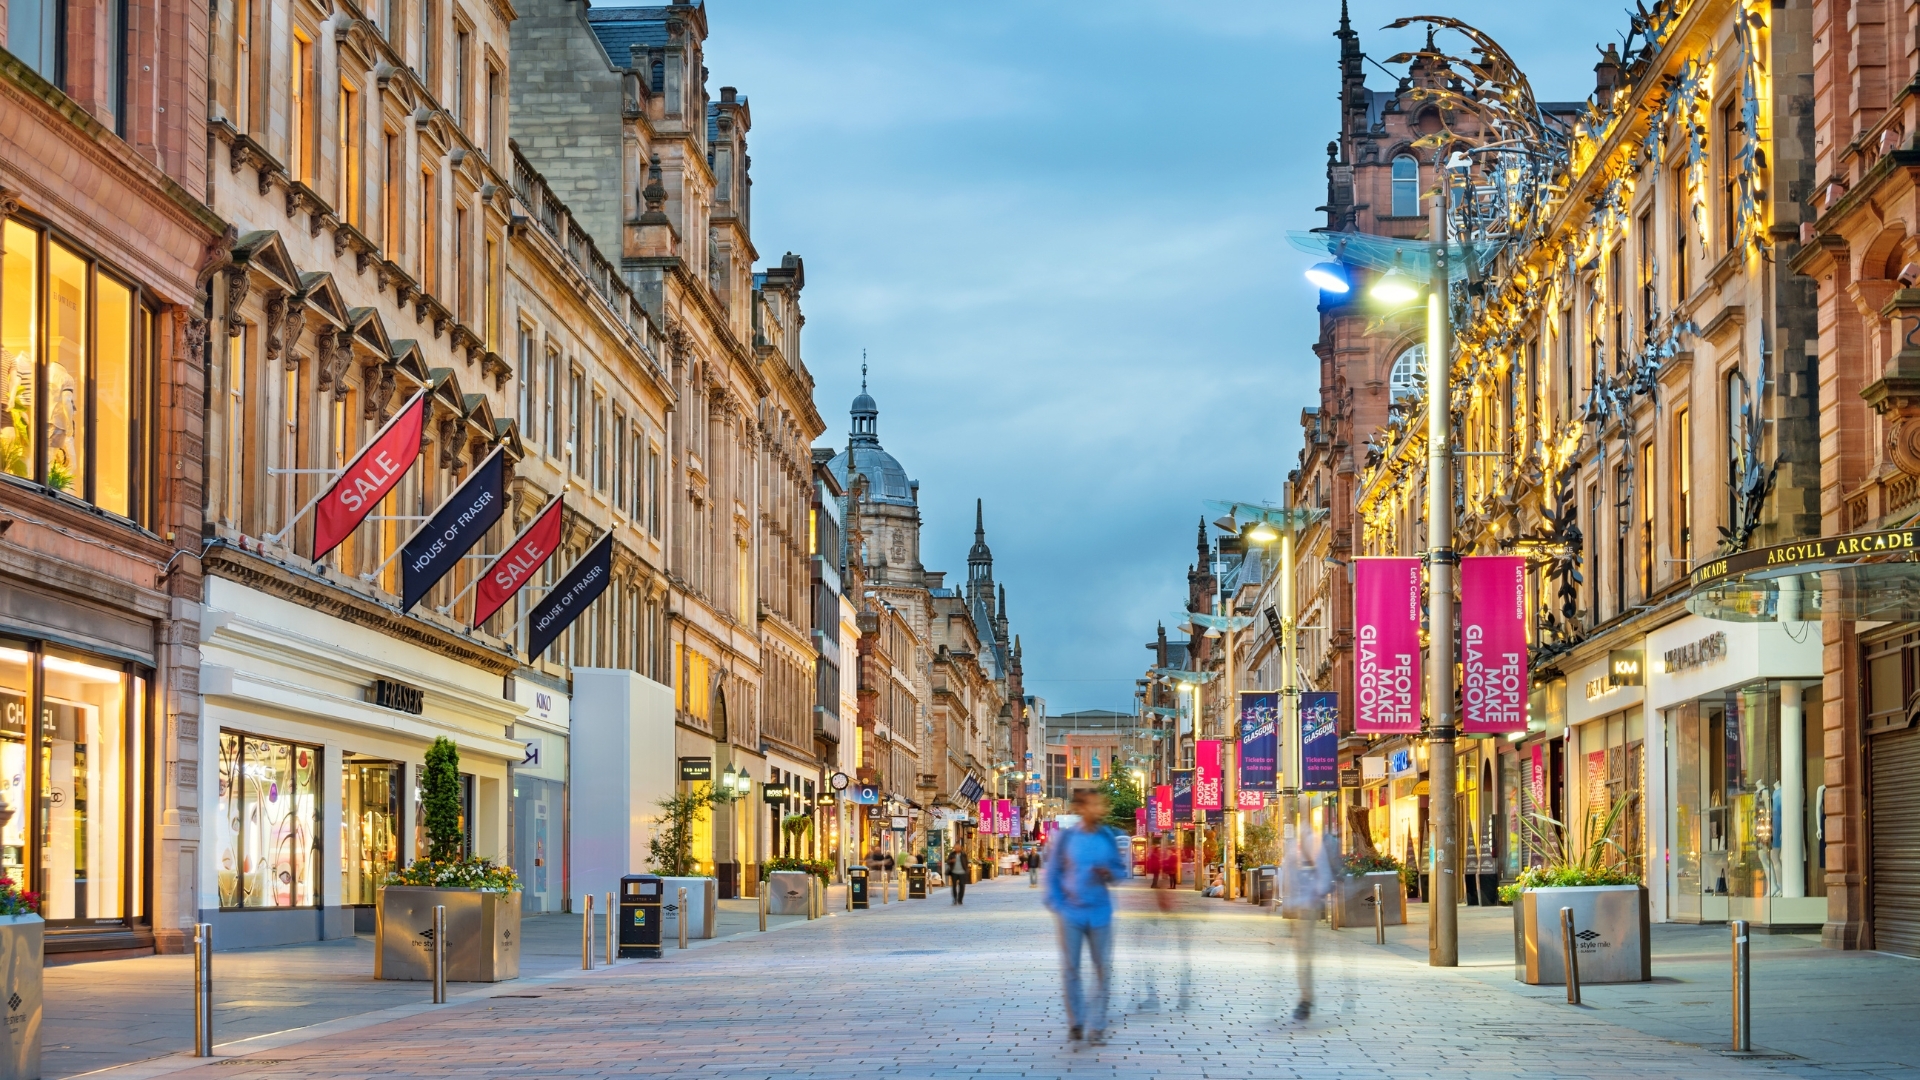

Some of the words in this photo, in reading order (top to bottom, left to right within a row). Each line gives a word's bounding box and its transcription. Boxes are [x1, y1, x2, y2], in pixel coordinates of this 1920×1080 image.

[53, 291, 77, 311] HOWICK
[340, 450, 401, 512] SALE
[412, 538, 447, 573] HOUSE
[444, 524, 459, 541] OF
[457, 491, 494, 527] FRASER
[1767, 543, 1825, 565] ARGYLL
[1836, 531, 1913, 555] ARCADE
[495, 540, 544, 590] SALE
[1700, 560, 1727, 582] ARCADE
[535, 603, 564, 632] HOUSE
[561, 591, 574, 606] OF
[572, 565, 603, 596] FRASER
[1409, 586, 1417, 621] Celebrate
[1360, 624, 1377, 723] GLASGOW
[1466, 624, 1484, 722] GLASGOW
[1615, 660, 1638, 674] KM
[384, 681, 425, 714] FRASERS
[536, 692, 551, 711] KIKO
[1378, 669, 1394, 723] MAKE
[1395, 654, 1411, 723] PEOPLE
[1485, 668, 1502, 722] MAKE
[1502, 653, 1520, 722] PEOPLE
[8, 702, 56, 731] CHEL
[1243, 722, 1274, 744] GLASGOW
[1304, 722, 1333, 744] GLASGOW
[1393, 750, 1408, 773] OFFICE
[767, 789, 783, 797] BOSS
[862, 788, 875, 801] O2
[1203, 784, 1211, 806] MAKE
[1210, 778, 1218, 806] PEOPLE
[1580, 941, 1596, 949] style
